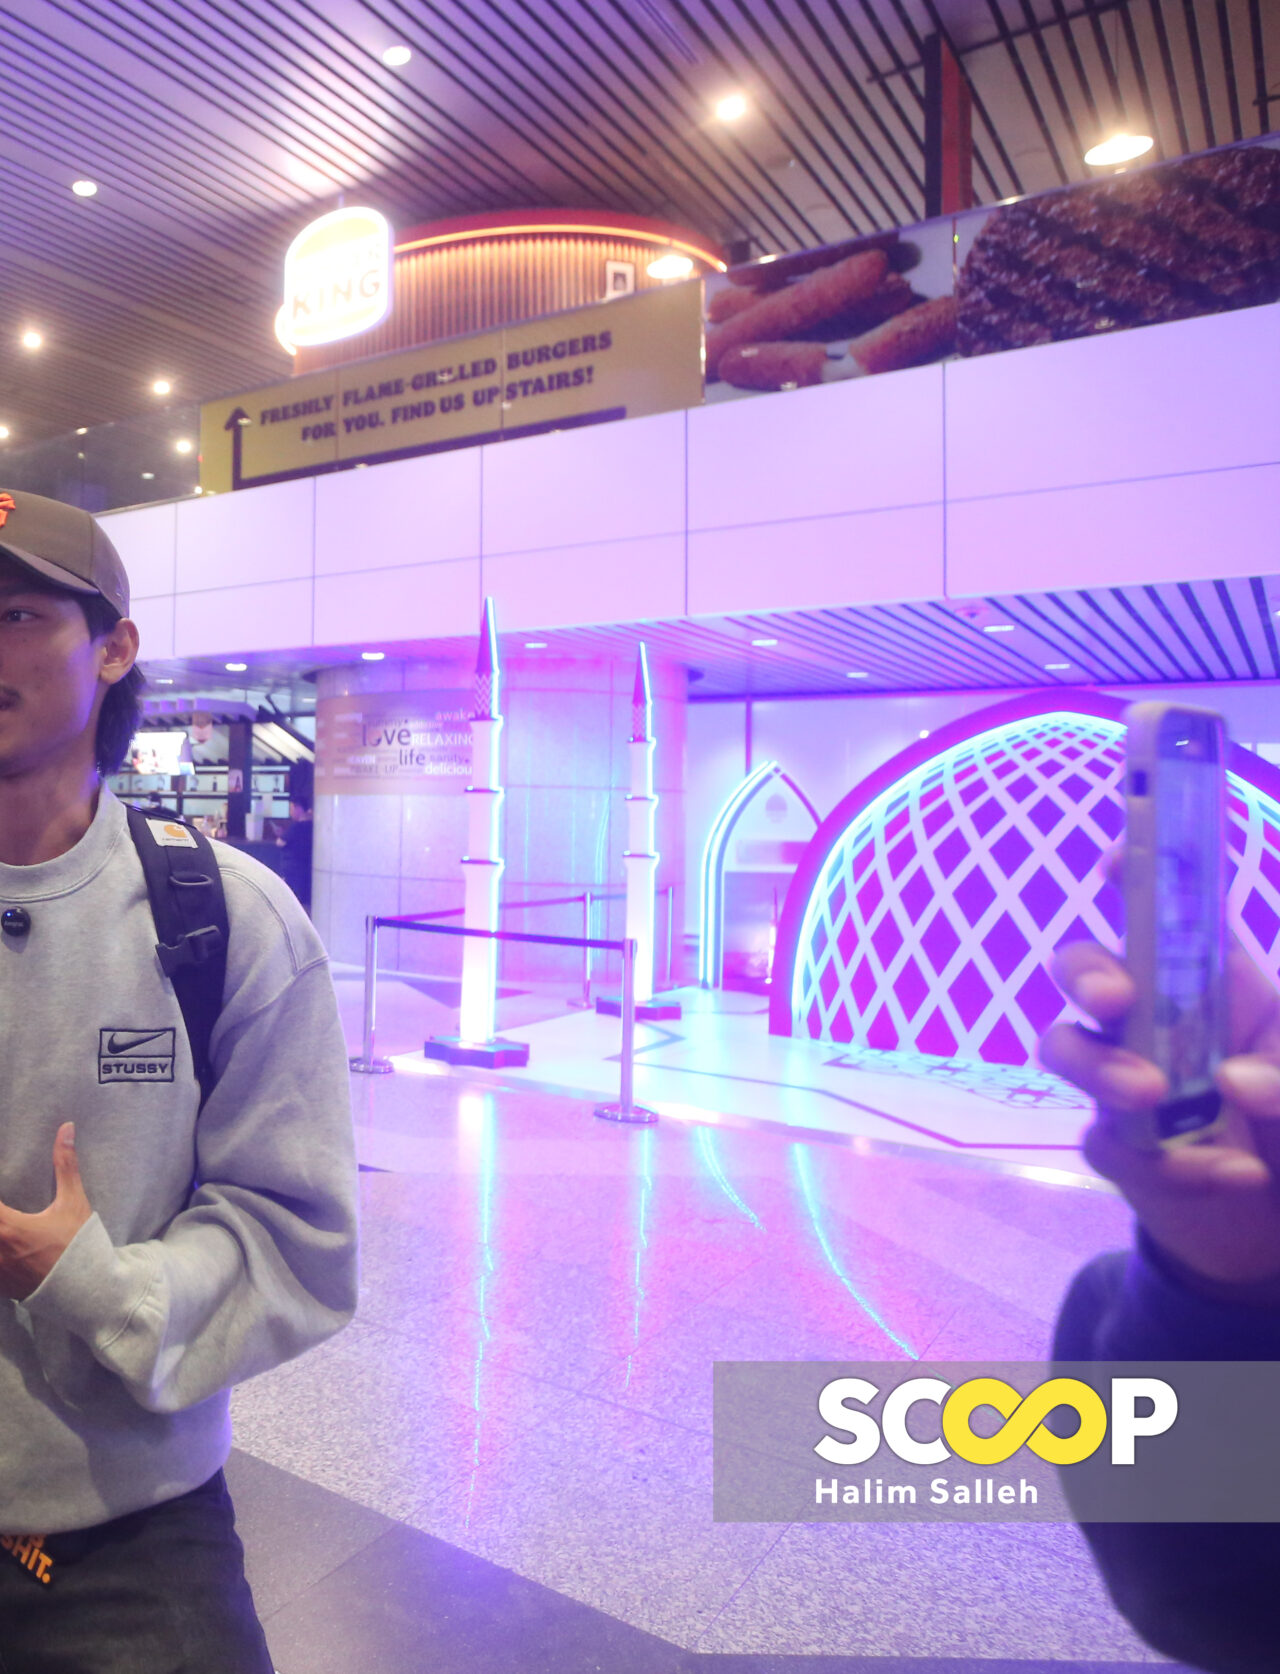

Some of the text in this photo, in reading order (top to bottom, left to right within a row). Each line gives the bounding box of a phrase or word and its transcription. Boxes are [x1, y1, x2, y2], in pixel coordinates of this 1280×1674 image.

[292, 269, 381, 321] KING
[260, 394, 335, 426] FRESHLY
[507, 330, 612, 371] BURGERS
[301, 421, 337, 441] FOR
[343, 411, 385, 434] YOU.
[391, 401, 436, 424] FIND
[439, 393, 465, 414] US
[361, 724, 411, 747] love
[399, 749, 426, 766] life
[424, 763, 473, 776] deliciou
[102, 1063, 168, 1075] STUSSY
